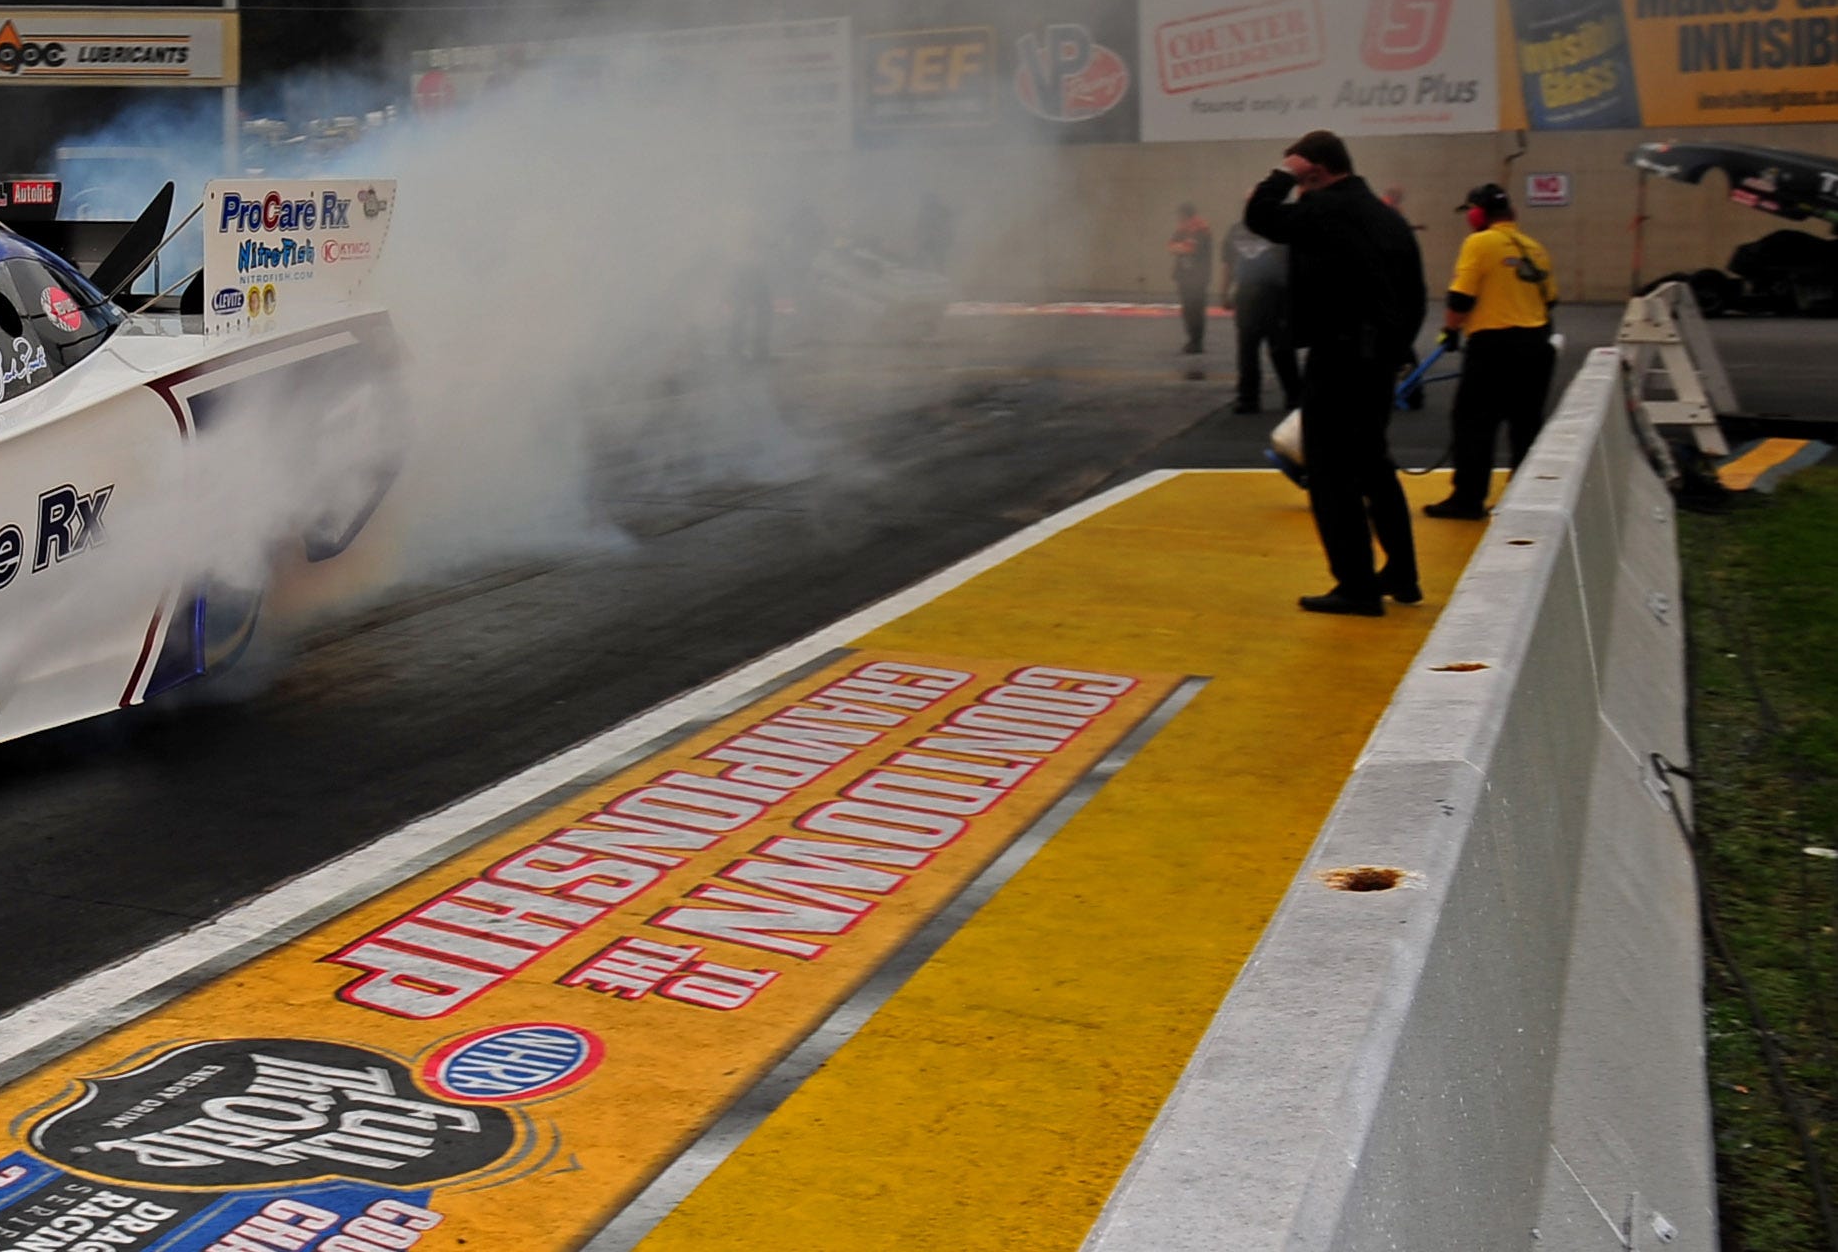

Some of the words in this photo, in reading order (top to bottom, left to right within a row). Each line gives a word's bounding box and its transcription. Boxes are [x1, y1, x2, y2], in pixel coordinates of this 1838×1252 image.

[77, 46, 191, 64] LUBRICANTS
[1332, 79, 1407, 109] Auto
[1413, 74, 1479, 105] Plus
[14, 184, 54, 203] Autolite
[219, 191, 317, 233] ProCare
[320, 191, 351, 229] Rx
[239, 272, 314, 284] NITROFISH.COM
[31, 483, 115, 575] Rx
[648, 664, 1143, 961] COUNTDOWN
[317, 659, 977, 1020] CHAMPIONSHIP
[554, 935, 706, 1001] THE
[652, 960, 782, 1011] TO
[159, 1063, 227, 1103] ENERGY
[458, 1029, 580, 1094] NHRA
[100, 1097, 166, 1130] DRINK
[0, 1189, 138, 1252] RACIN
